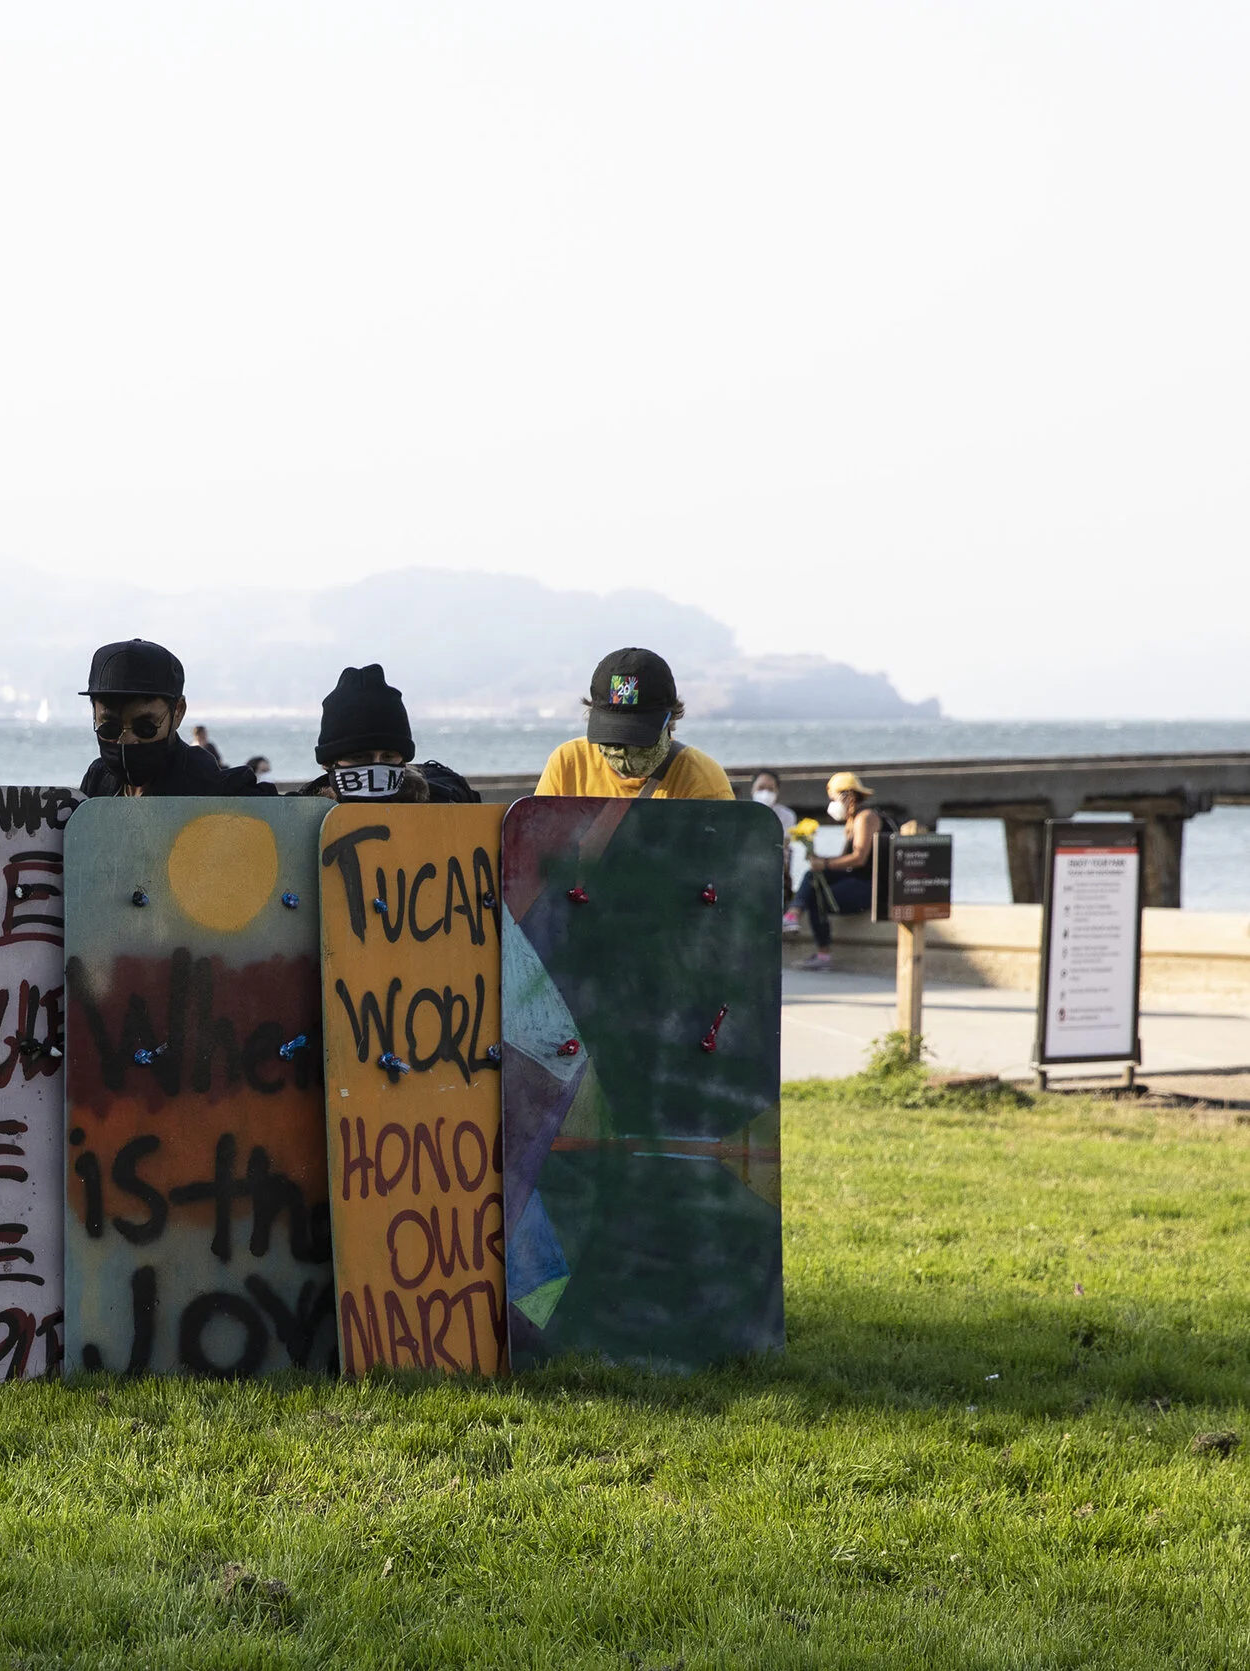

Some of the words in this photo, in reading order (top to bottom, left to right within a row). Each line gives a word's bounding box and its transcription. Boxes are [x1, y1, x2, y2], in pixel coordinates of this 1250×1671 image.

[618, 684, 631, 696] 20
[339, 768, 405, 792] BLM
[336, 974, 502, 1085] WORL
[69, 1127, 168, 1246] is
[386, 1192, 506, 1290] OUR
